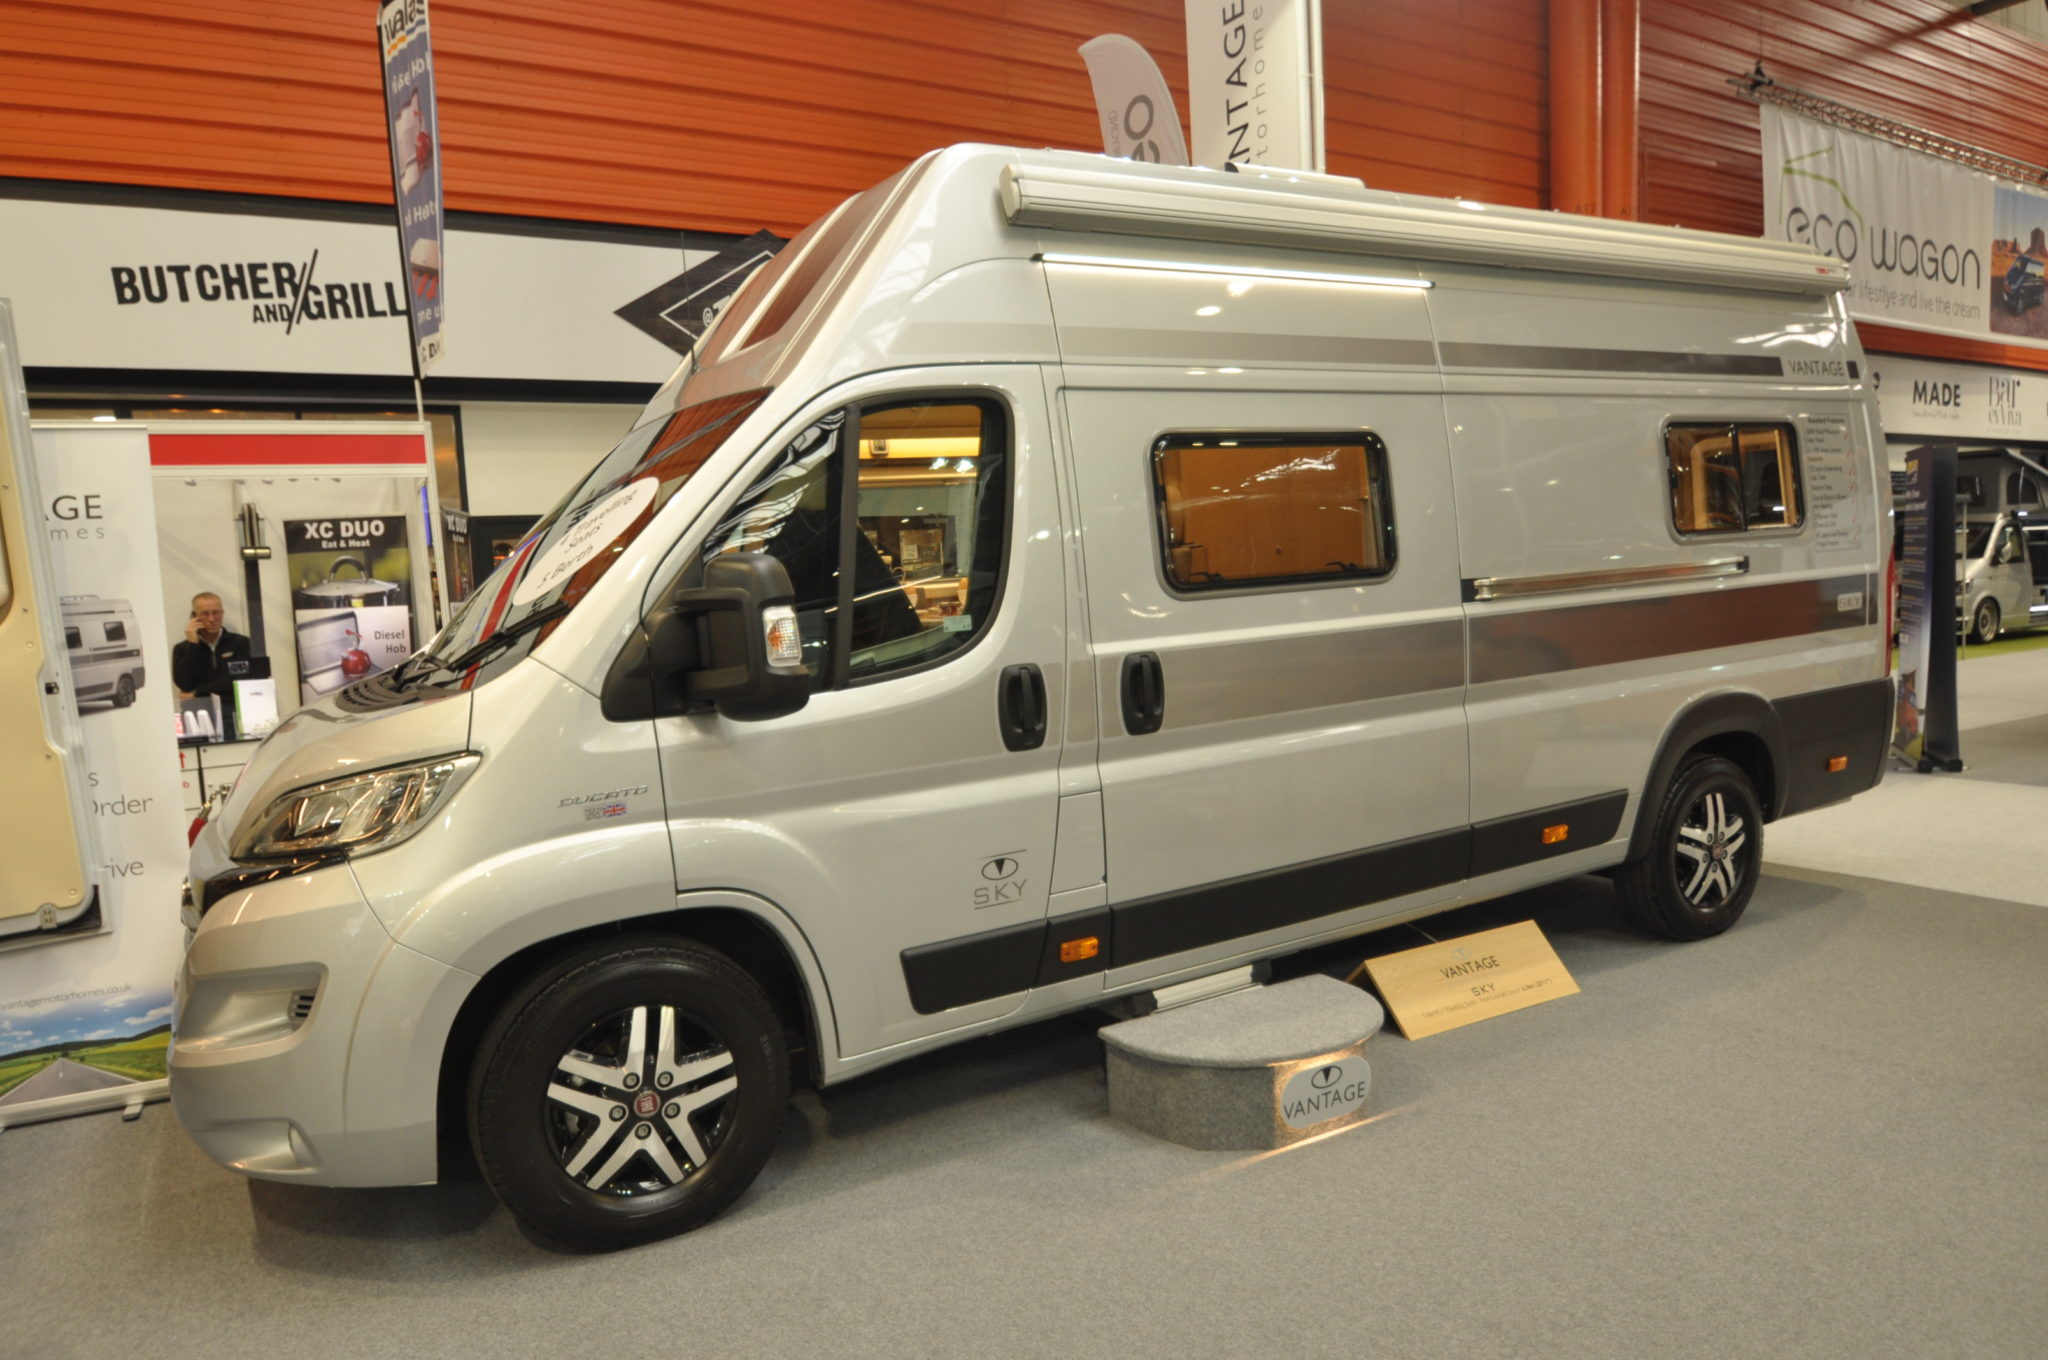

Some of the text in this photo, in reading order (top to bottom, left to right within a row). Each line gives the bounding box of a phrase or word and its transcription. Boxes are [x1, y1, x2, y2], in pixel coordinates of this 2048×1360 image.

[1222, 0, 1250, 164] NTAGE
[1251, 5, 1268, 157] torhome
[111, 262, 299, 305] BUTCHER
[253, 303, 291, 323] AND
[303, 282, 410, 320] GRILL
[1899, 290, 1918, 309] and
[1935, 295, 1951, 314] the
[1952, 298, 1980, 320] dream
[1788, 359, 1844, 377] VANTAGE
[1912, 379, 1961, 407] MADE
[304, 520, 385, 539] XC DUO
[348, 539, 370, 548] Heat
[374, 629, 405, 640] Diesel
[386, 643, 406, 654] Hob
[974, 879, 1027, 905] SKY
[1440, 955, 1500, 979] VANTAGE
[1471, 983, 1496, 997] SKY
[1283, 1080, 1366, 1120] VANTAGE
